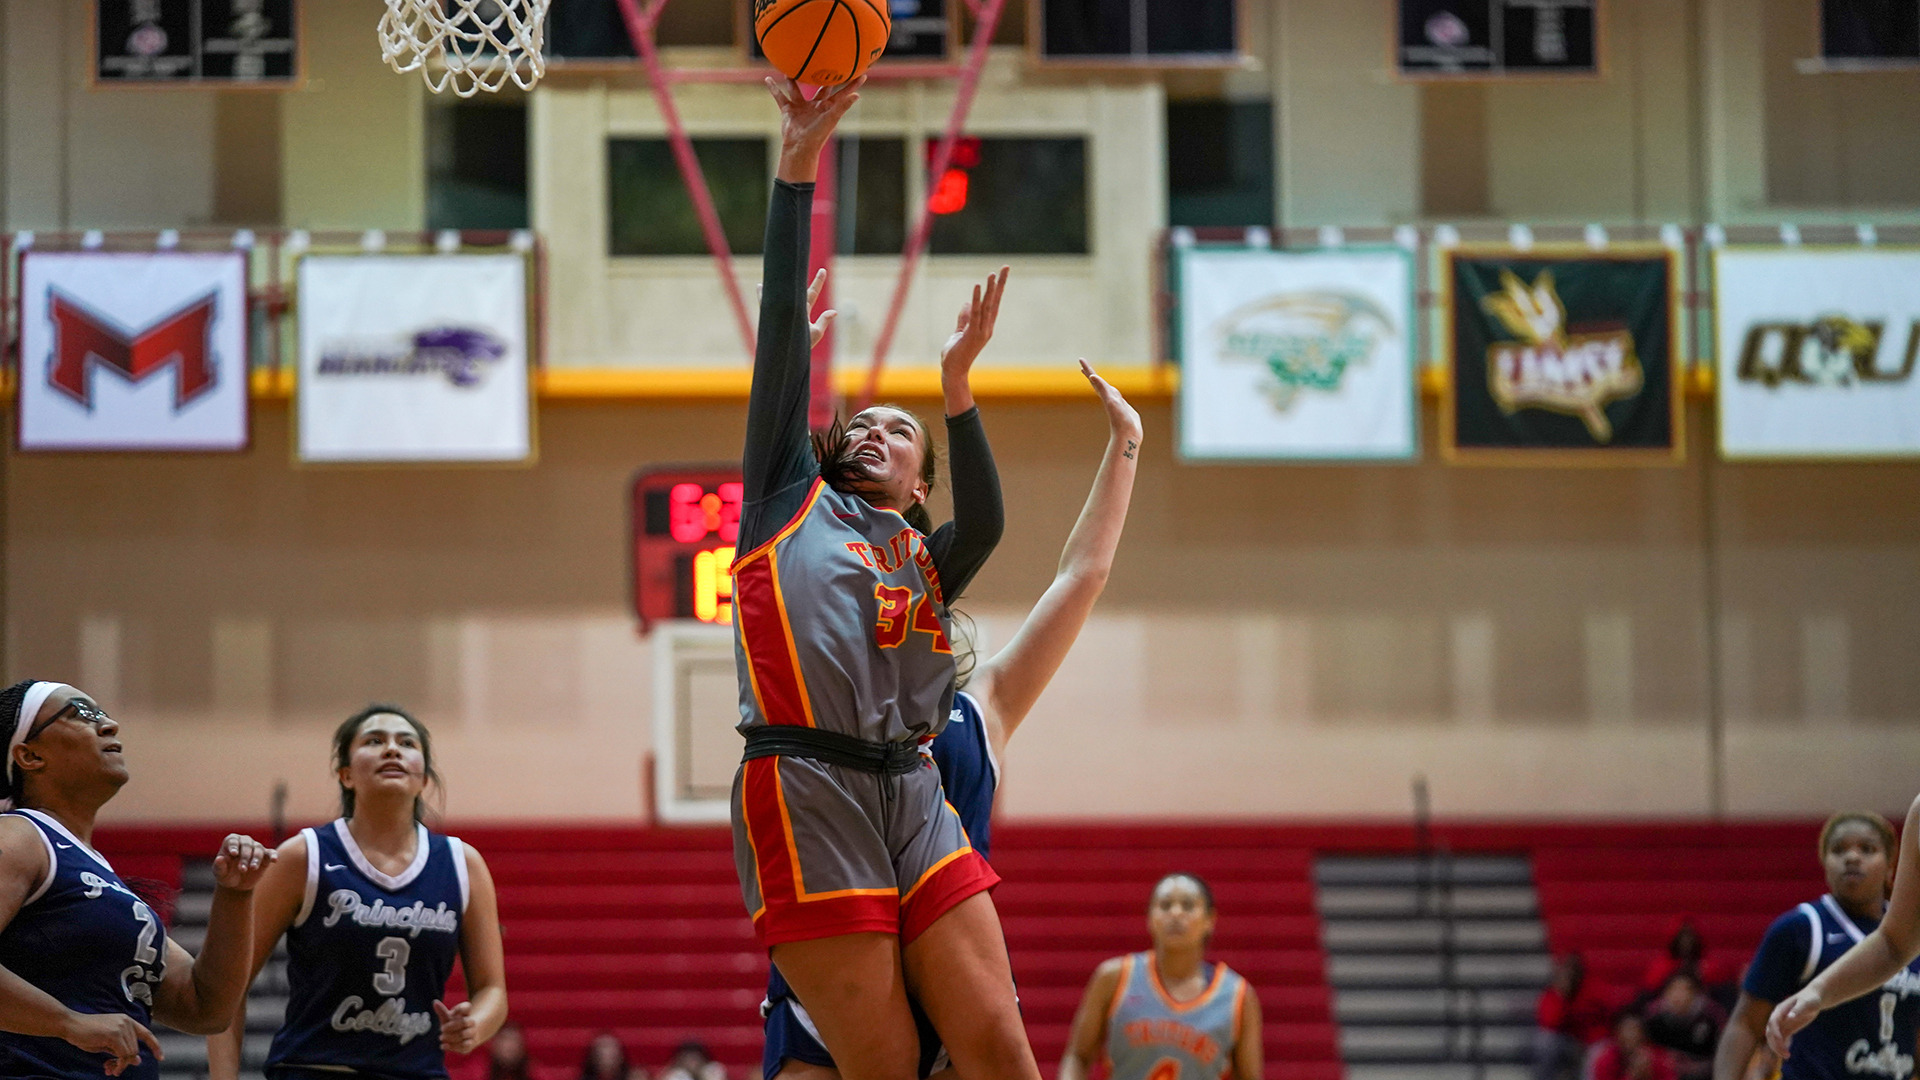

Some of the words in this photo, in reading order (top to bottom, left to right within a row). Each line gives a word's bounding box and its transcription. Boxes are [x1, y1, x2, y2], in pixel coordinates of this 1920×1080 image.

[874, 582, 953, 655] 34
[323, 889, 457, 937] Principia
[373, 936, 411, 996] 3
